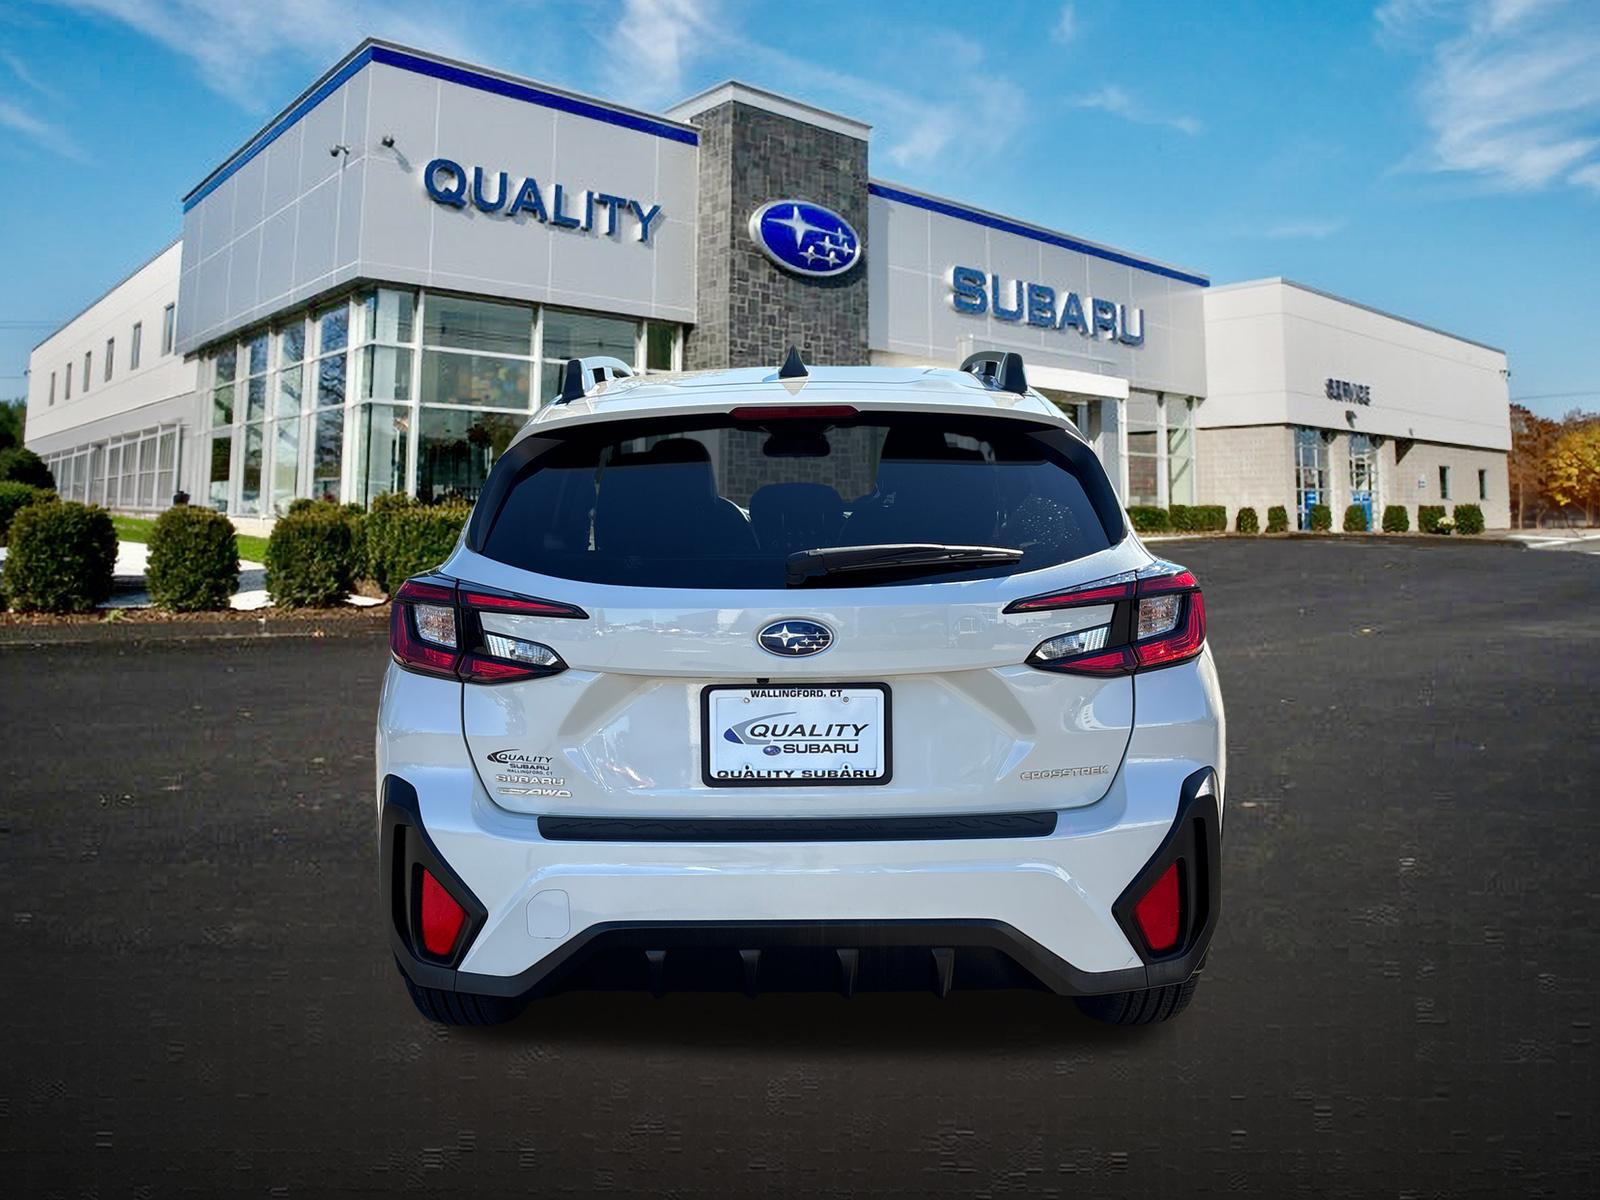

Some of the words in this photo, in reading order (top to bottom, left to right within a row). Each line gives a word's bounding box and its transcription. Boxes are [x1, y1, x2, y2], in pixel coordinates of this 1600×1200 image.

[423, 158, 662, 243] QUALITY
[946, 265, 1145, 346] SUBARU
[1325, 377, 1371, 406] SERVICE
[830, 689, 842, 698] CT
[749, 724, 869, 738] QUALITY
[783, 743, 858, 753] SUBARU
[498, 753, 553, 763] QUALITY
[717, 770, 795, 778] QUALITY
[801, 770, 877, 778] SUBARU
[1020, 765, 1109, 780] CROSSTREK
[495, 774, 565, 786] SUBARU
